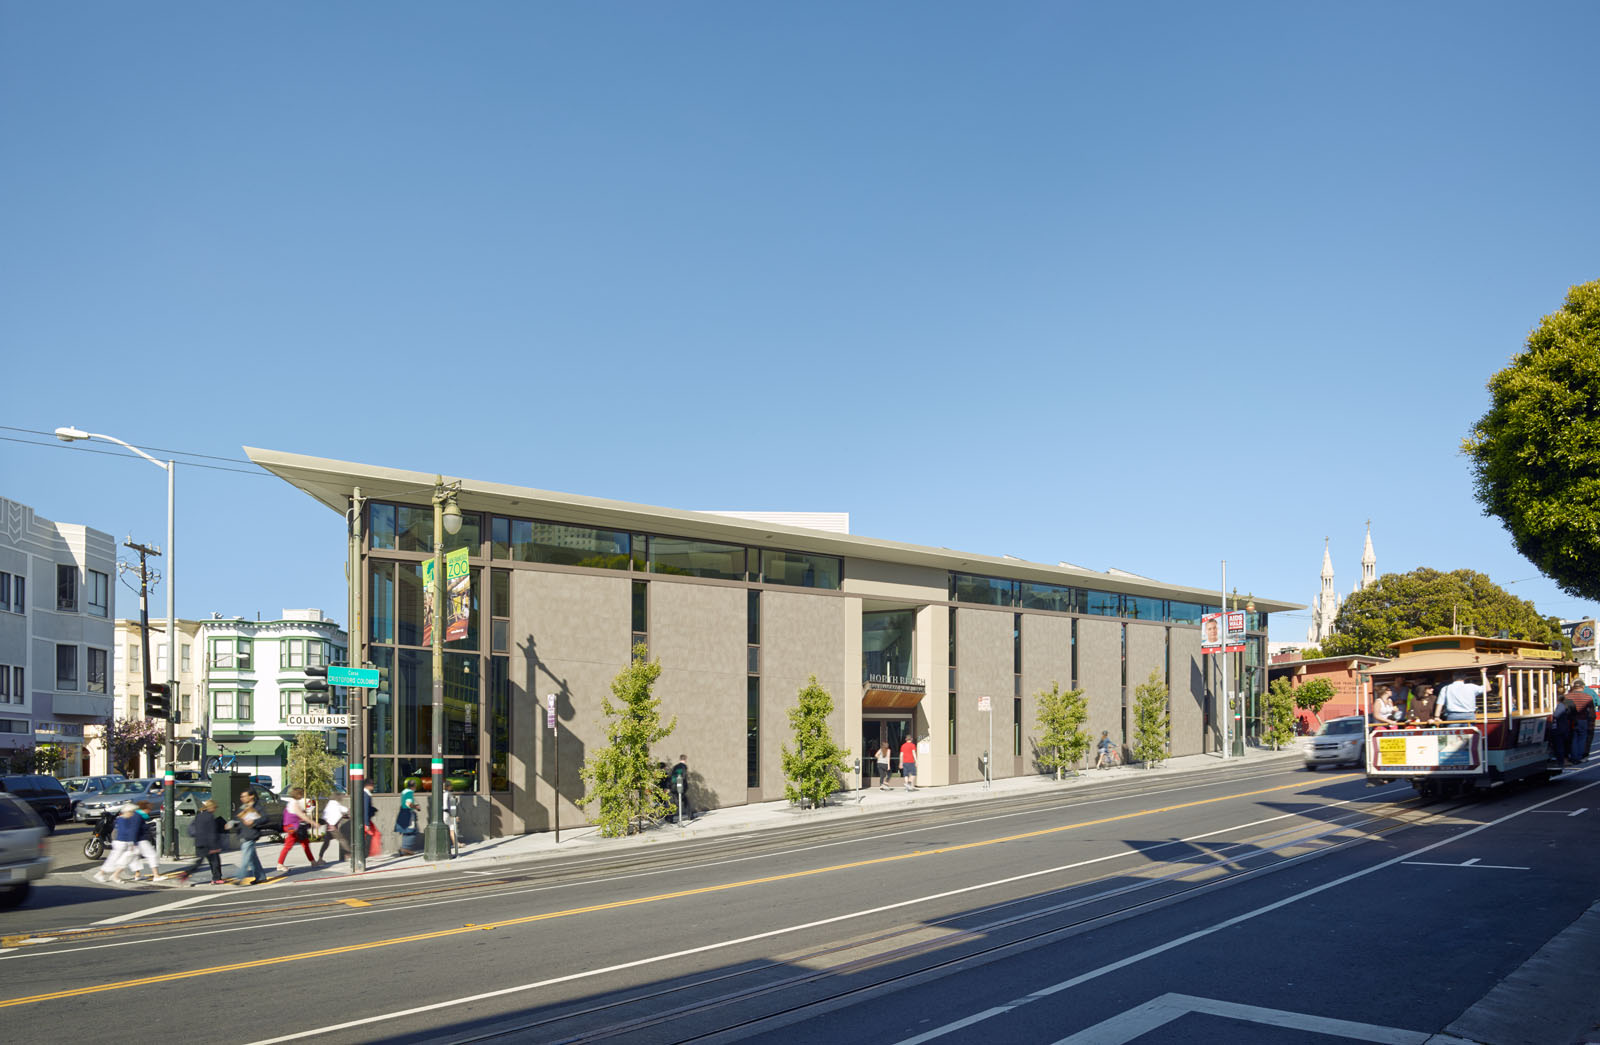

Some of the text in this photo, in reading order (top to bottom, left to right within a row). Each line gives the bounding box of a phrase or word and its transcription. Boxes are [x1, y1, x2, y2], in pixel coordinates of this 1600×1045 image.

[448, 560, 468, 577] ZOO
[870, 674, 898, 684] NORTH
[289, 716, 346, 724] COLUMBUS
